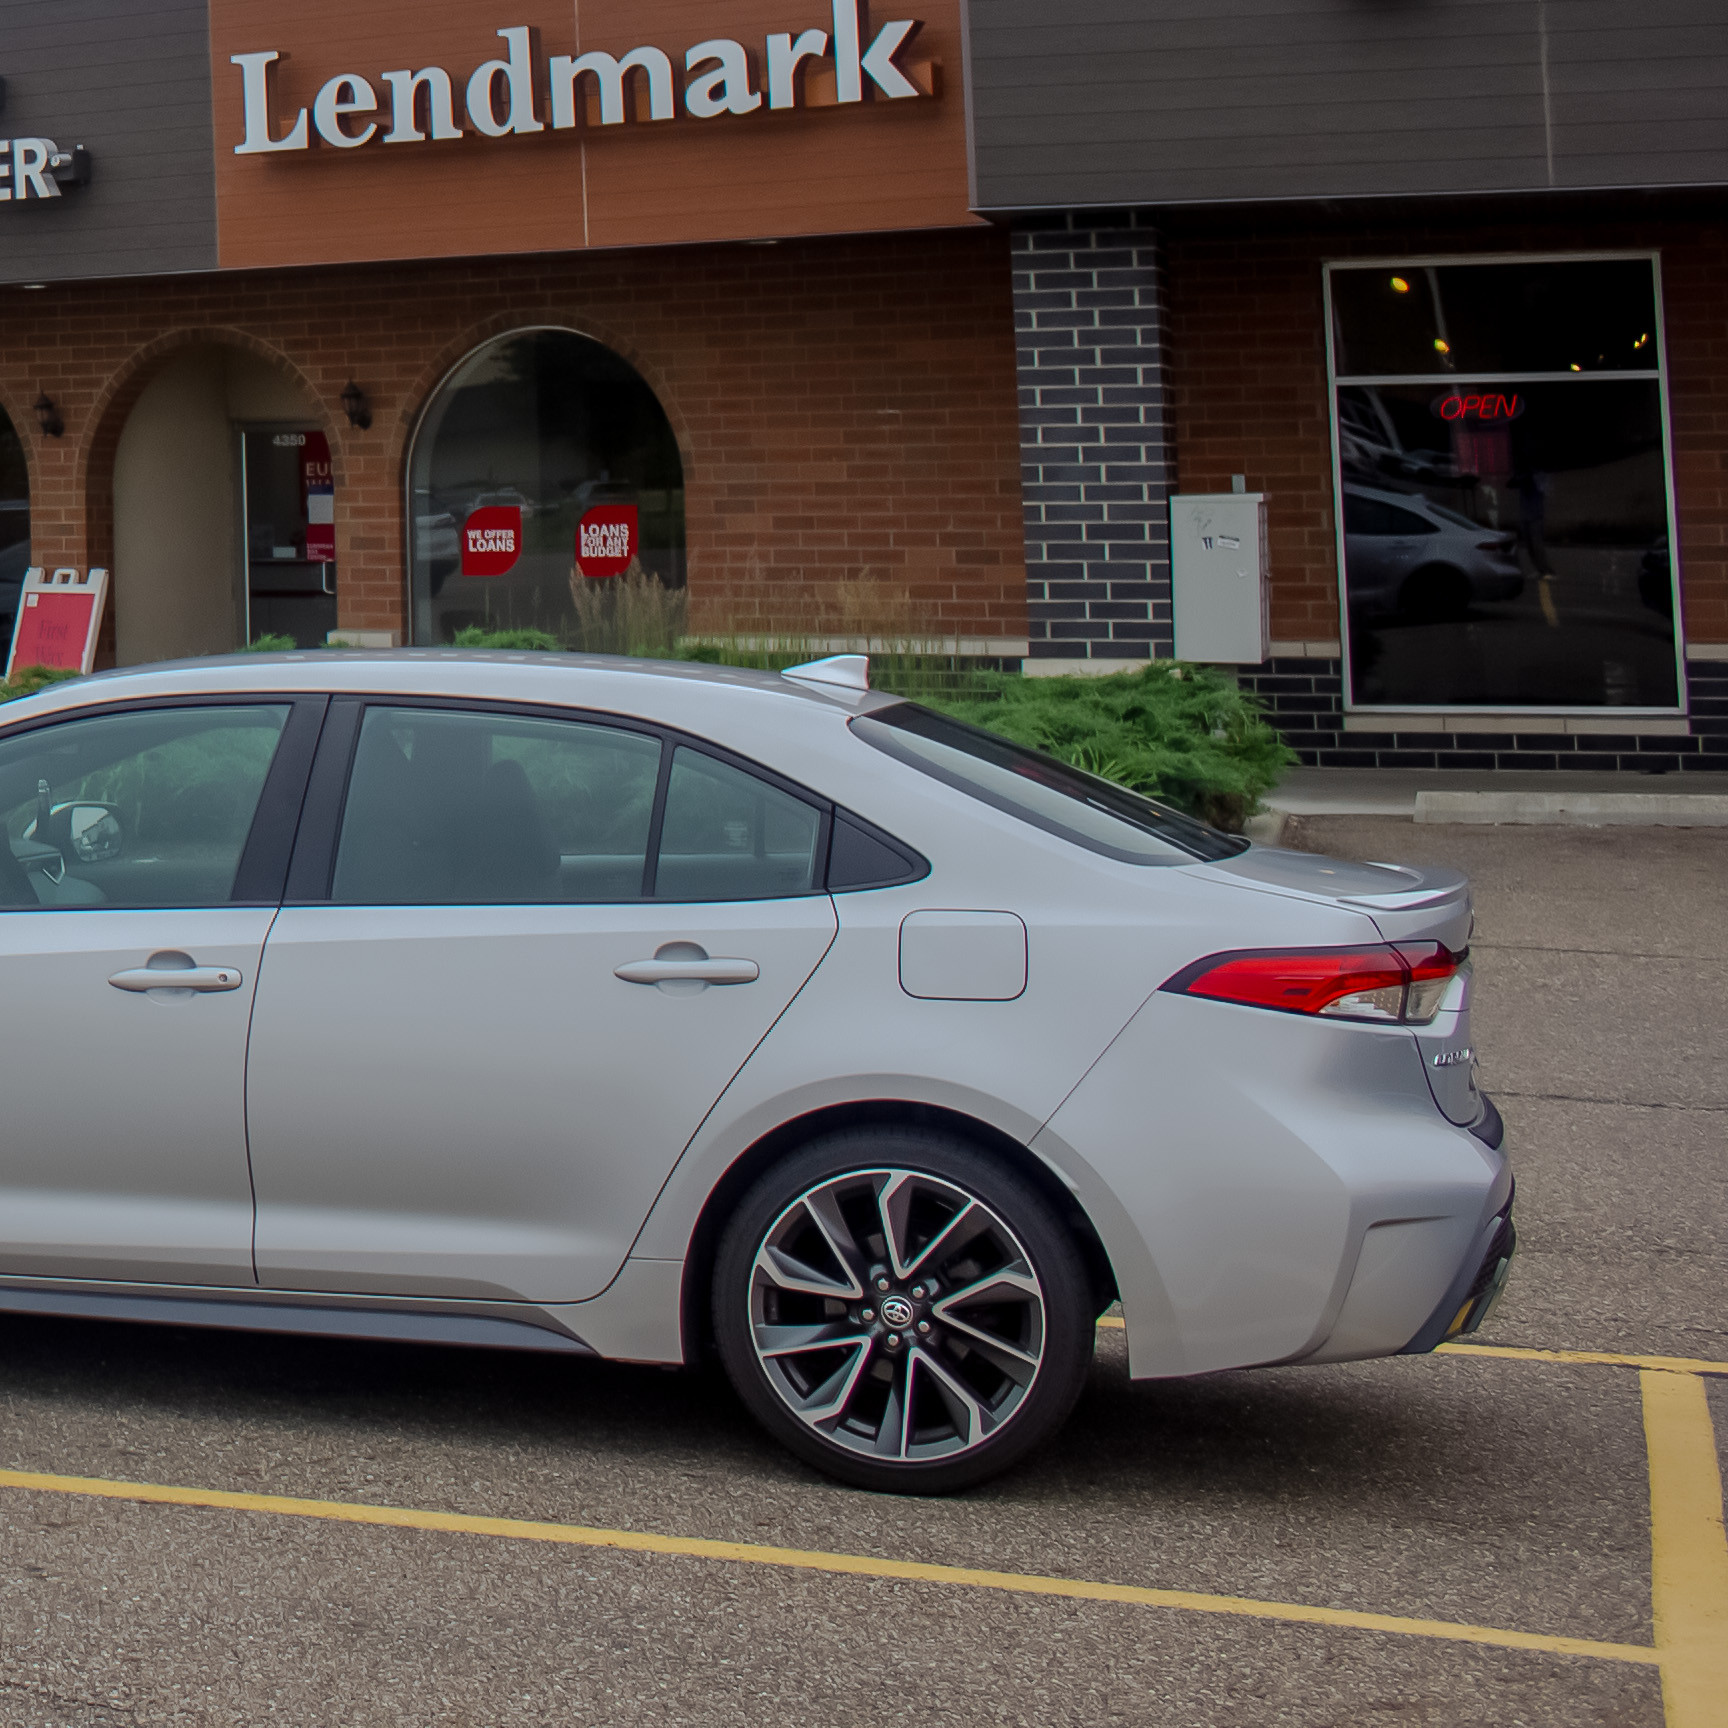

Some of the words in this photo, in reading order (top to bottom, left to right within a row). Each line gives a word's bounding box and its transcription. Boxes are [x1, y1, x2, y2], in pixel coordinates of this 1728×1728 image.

[1440, 393, 1518, 420] OPEN
[467, 529, 482, 539] WE
[484, 529, 515, 540] OFFER
[580, 523, 630, 537] LOANS
[468, 539, 515, 552] LOANS
[580, 546, 629, 557] BUDGET
